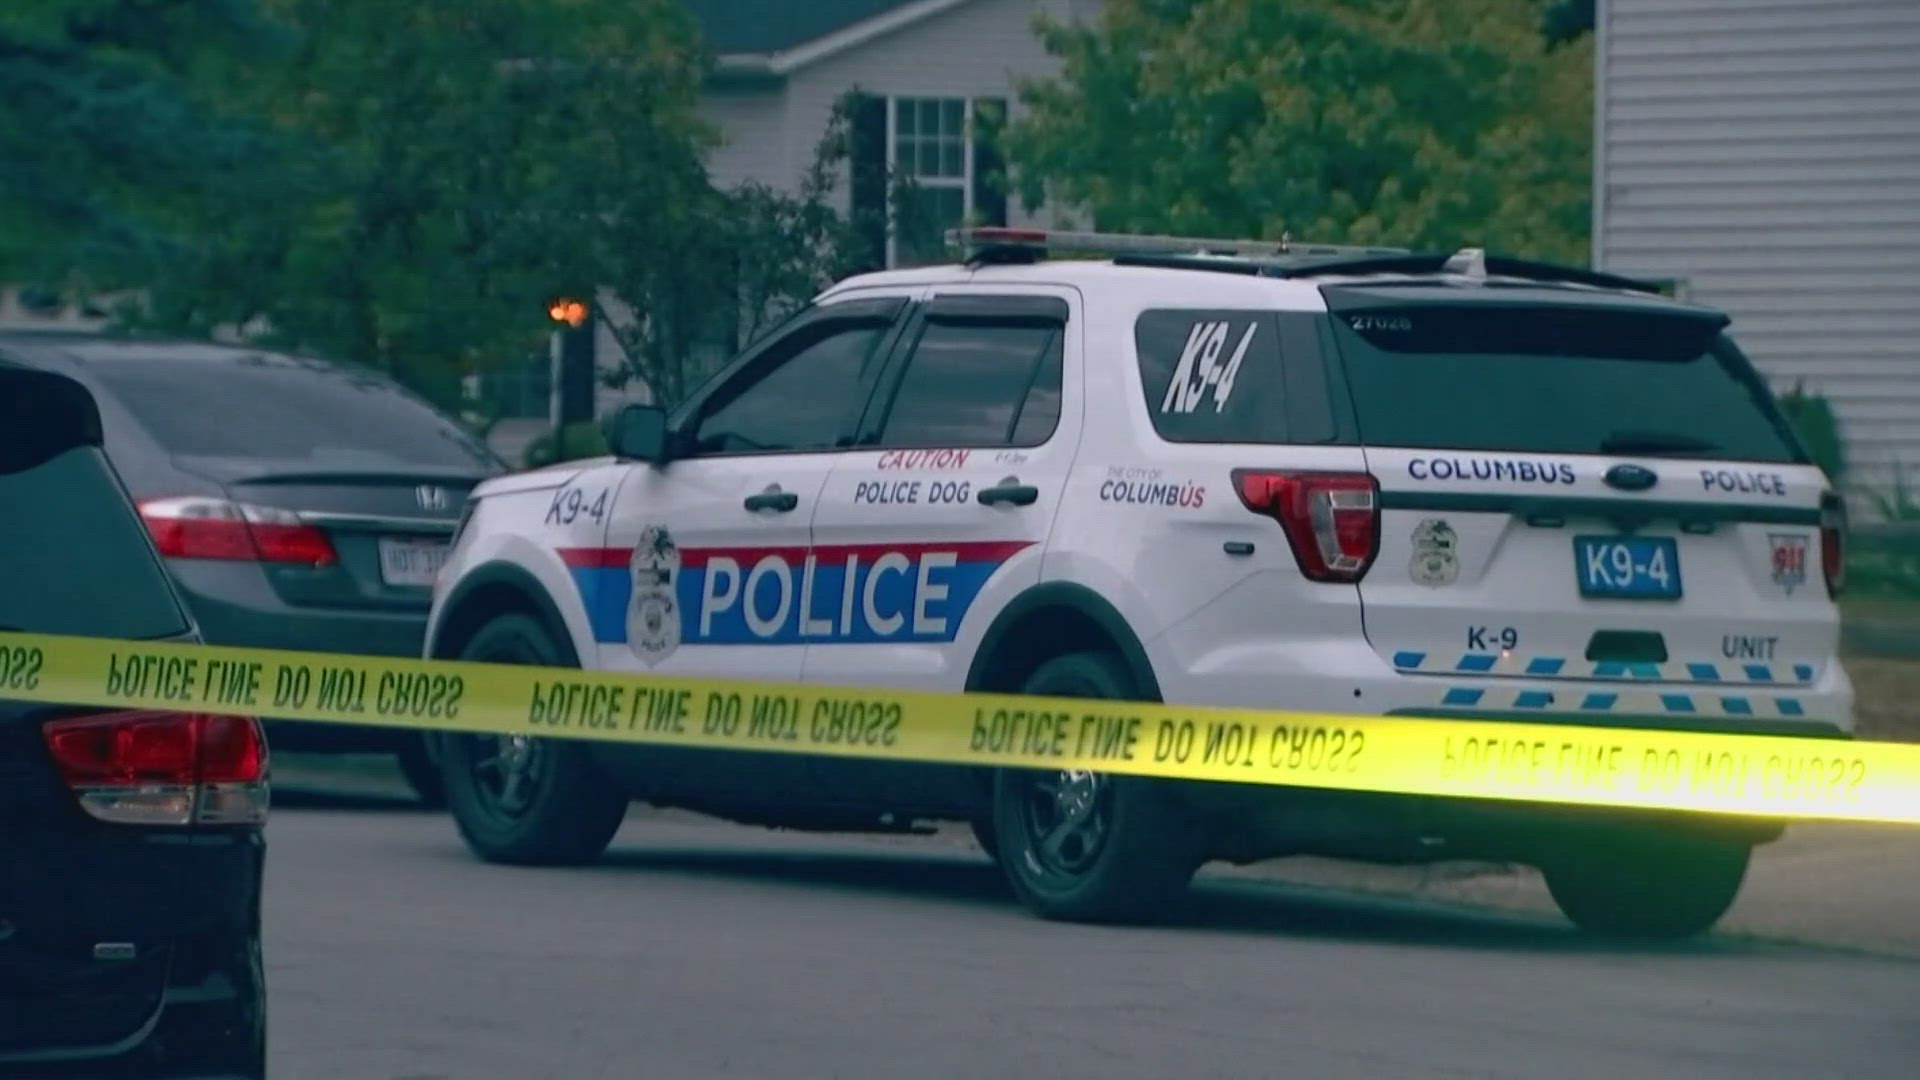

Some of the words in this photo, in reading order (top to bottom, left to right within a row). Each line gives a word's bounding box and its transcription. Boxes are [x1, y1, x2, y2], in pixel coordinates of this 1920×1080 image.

[1161, 321, 1258, 413] K9-4
[877, 449, 970, 470] CAUTION
[1408, 458, 1576, 485] COLUMBUS
[854, 480, 921, 504] POLICE
[928, 480, 971, 504] DOG
[1701, 470, 1786, 496] POLICE
[543, 488, 609, 526] K9-4
[1586, 542, 1669, 589] K9-4
[701, 551, 958, 638] POLICE
[1467, 626, 1518, 650] K-9
[1721, 635, 1779, 660] UNIT
